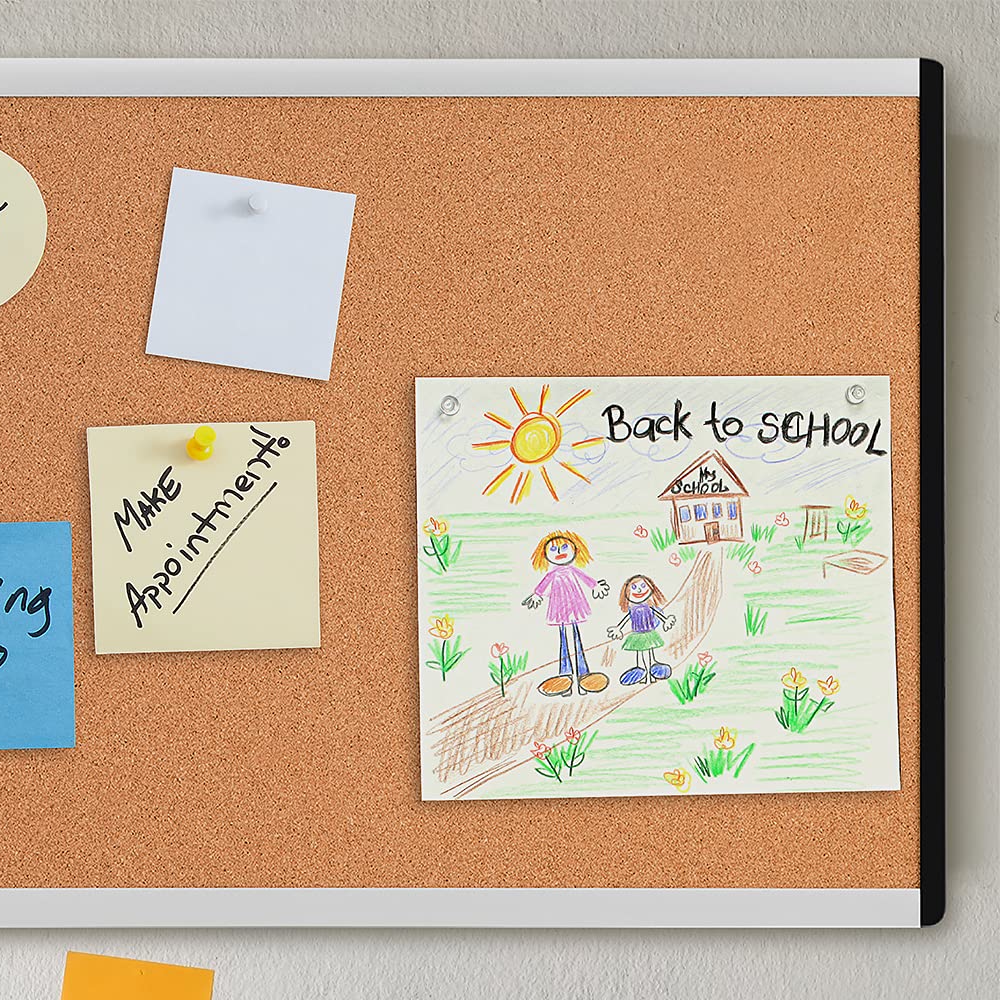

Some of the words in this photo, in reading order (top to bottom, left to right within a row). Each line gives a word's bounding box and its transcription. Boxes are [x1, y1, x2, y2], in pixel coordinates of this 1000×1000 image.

[601, 398, 694, 443] Back
[704, 401, 744, 443] to
[757, 411, 888, 457] SCHOOL
[113, 465, 182, 553] MAKE
[670, 478, 730, 495] SCHOOL
